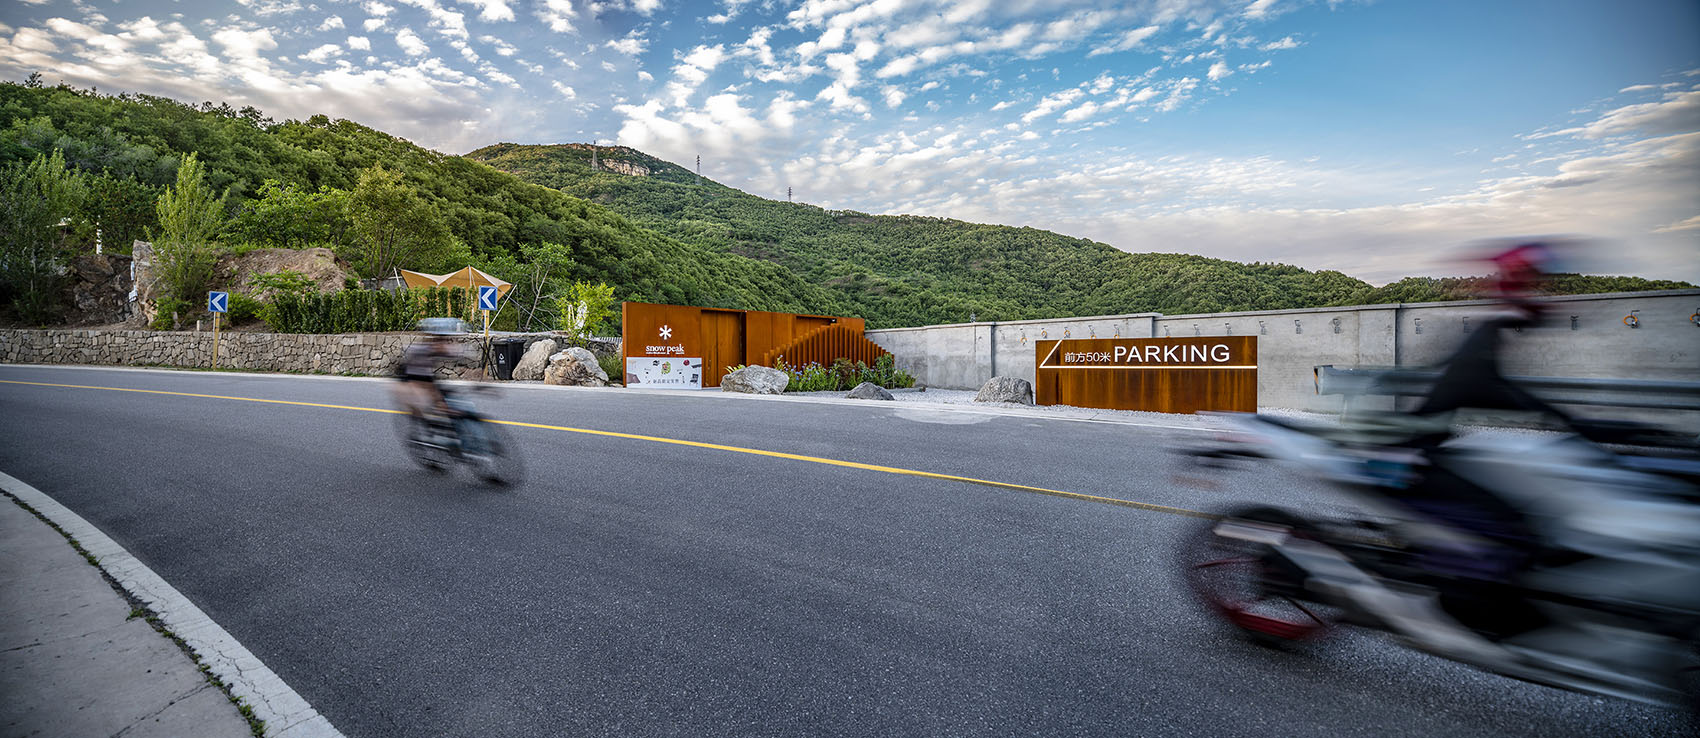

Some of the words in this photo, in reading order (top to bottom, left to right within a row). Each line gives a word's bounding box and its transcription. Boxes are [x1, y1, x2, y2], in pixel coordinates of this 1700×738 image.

[666, 343, 684, 354] peak
[1064, 351, 1111, 363] 前方50米
[1114, 344, 1230, 363] PARKING
